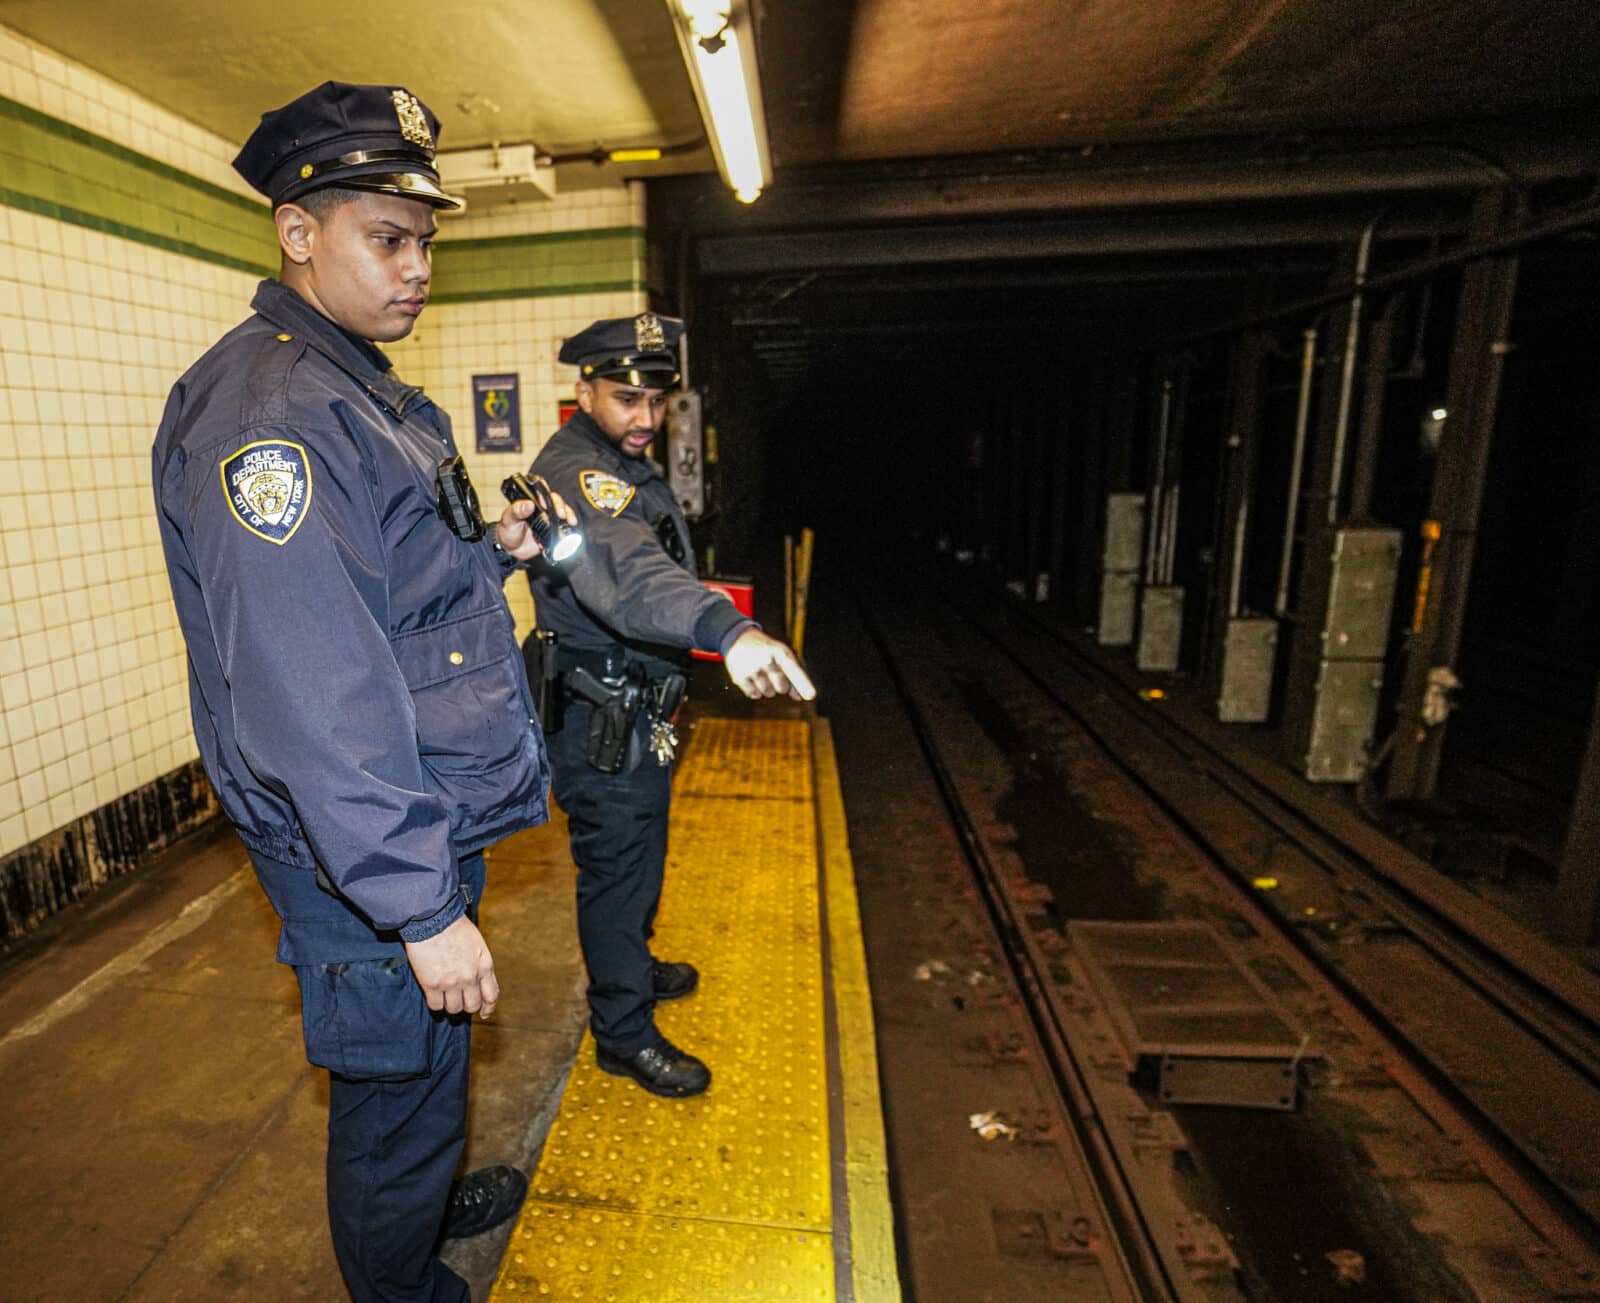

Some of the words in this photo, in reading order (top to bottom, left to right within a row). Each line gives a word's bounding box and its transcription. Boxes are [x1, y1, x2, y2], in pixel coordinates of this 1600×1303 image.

[232, 460, 298, 486] DEPARTMENT
[243, 450, 282, 466] POLICE
[234, 493, 252, 515] CITY
[250, 514, 265, 527] OF
[281, 505, 297, 527] NEW
[291, 480, 304, 505] YORK
